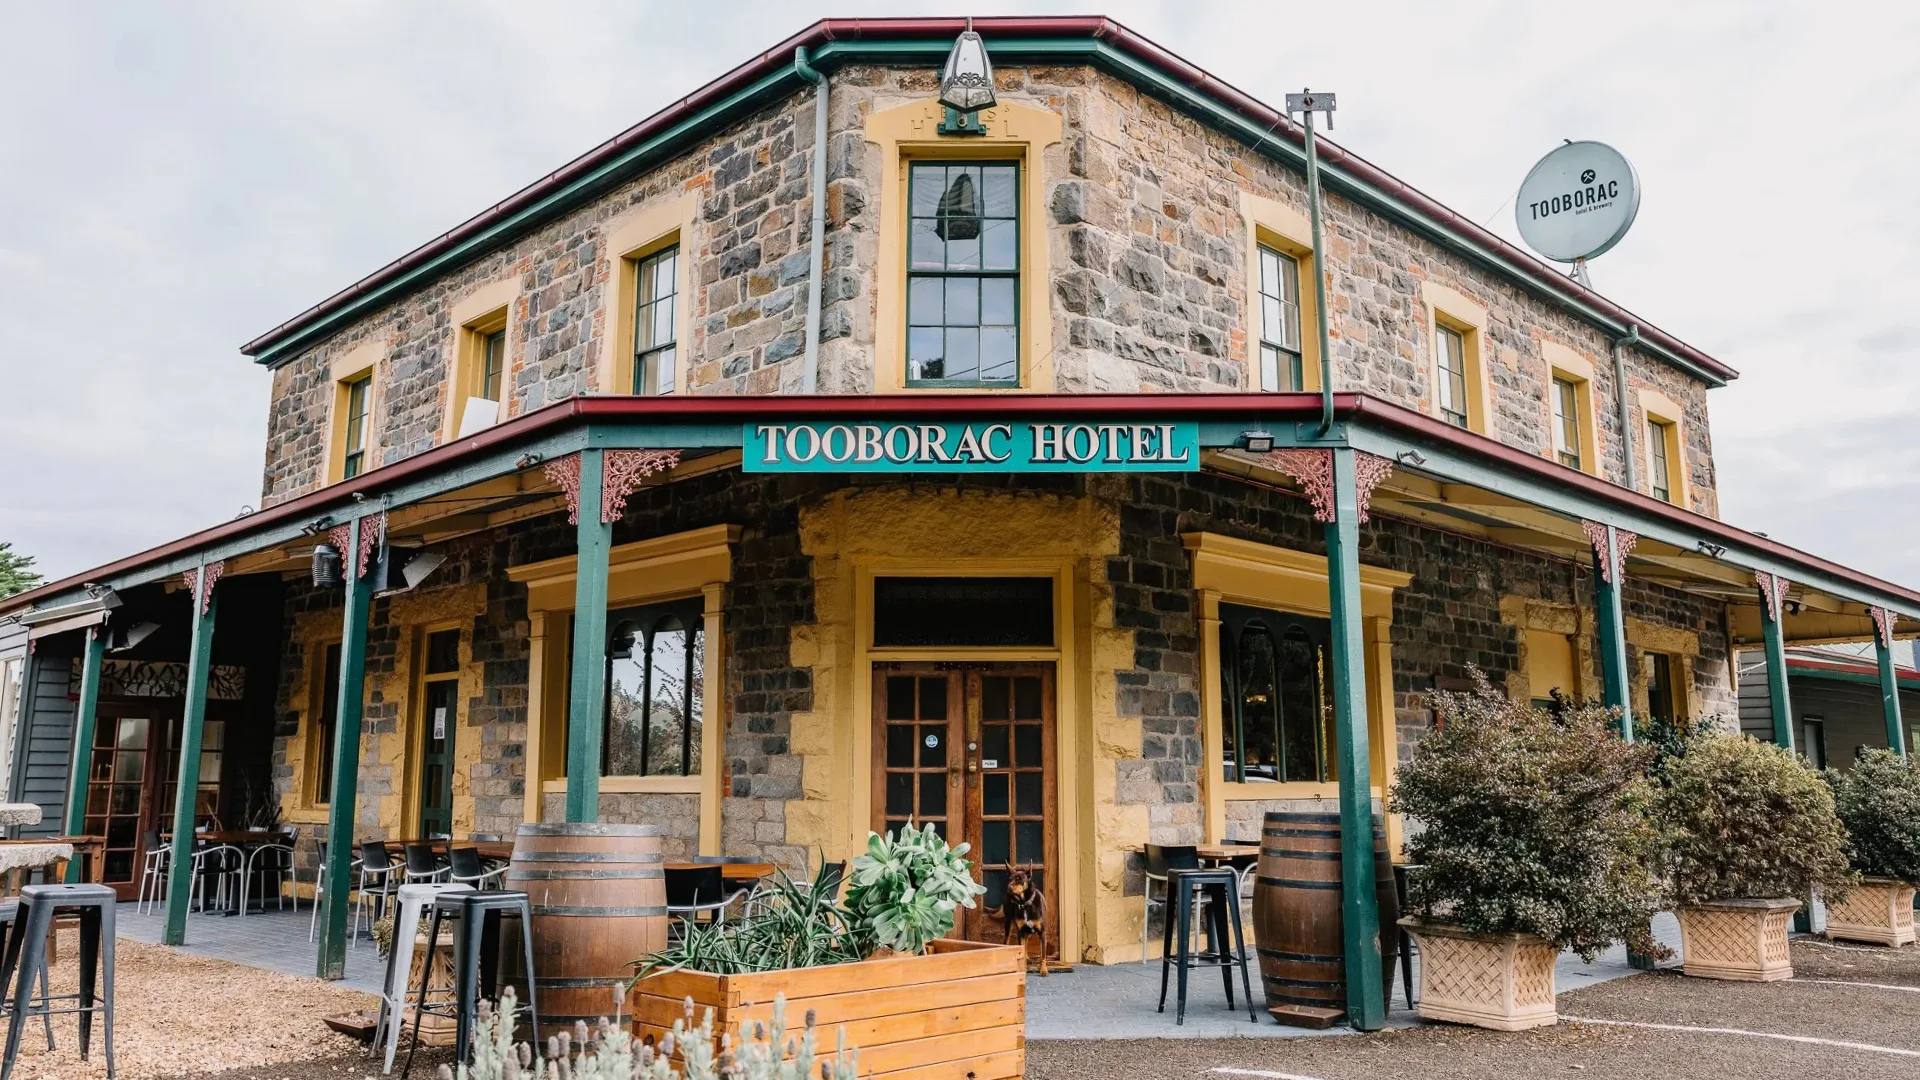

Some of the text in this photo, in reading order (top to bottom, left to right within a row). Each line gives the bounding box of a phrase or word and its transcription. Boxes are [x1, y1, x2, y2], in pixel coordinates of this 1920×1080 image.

[1530, 180, 1618, 220] TOOBORAC
[757, 423, 1190, 464] TOOBORAC HOTEL
